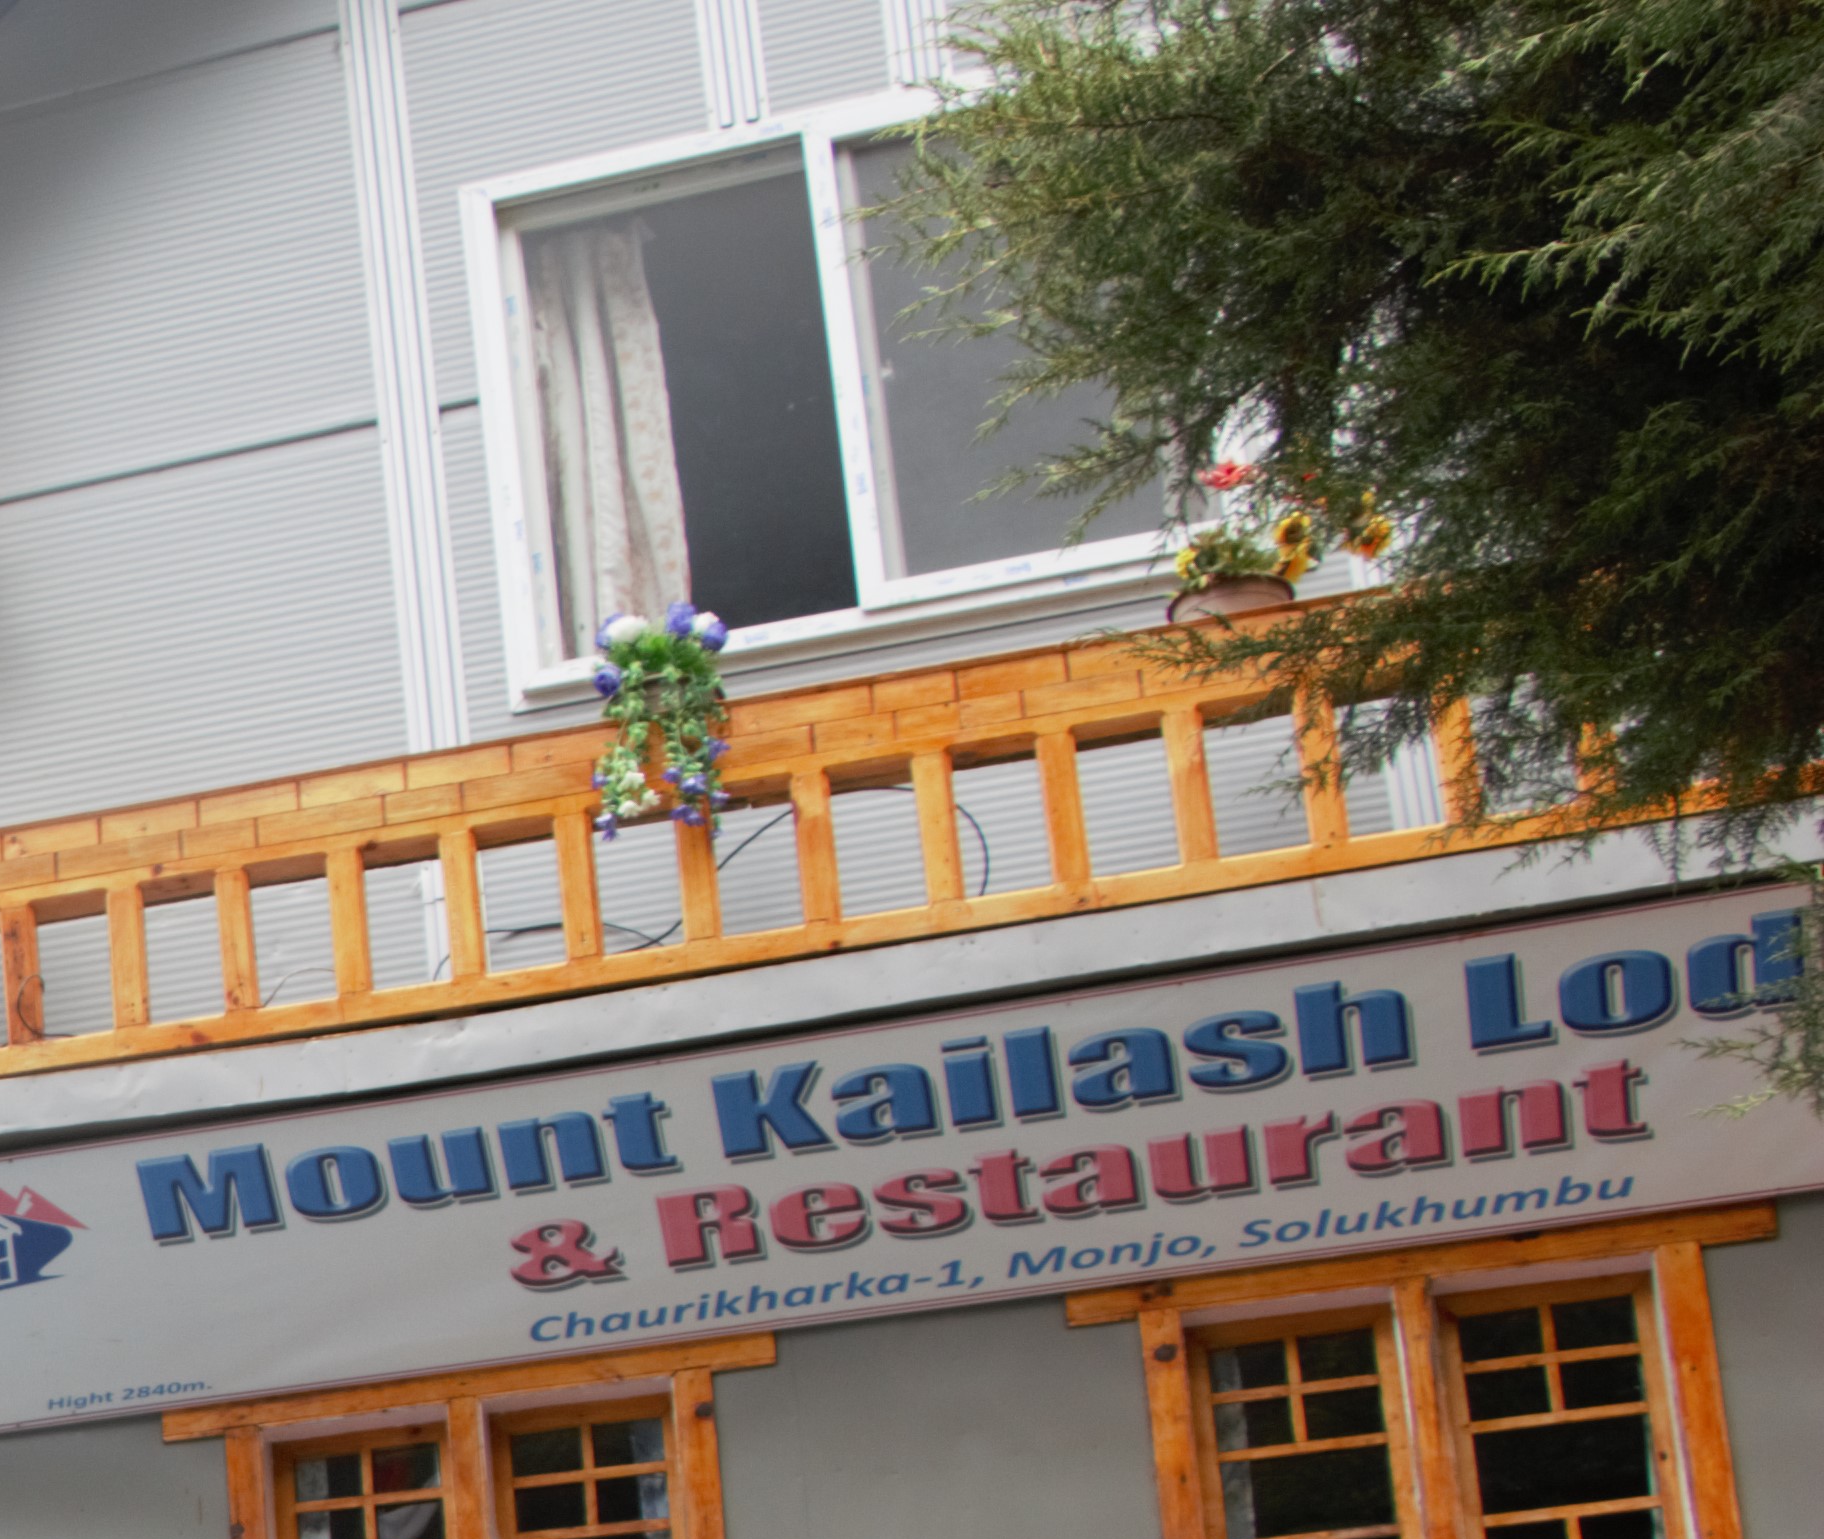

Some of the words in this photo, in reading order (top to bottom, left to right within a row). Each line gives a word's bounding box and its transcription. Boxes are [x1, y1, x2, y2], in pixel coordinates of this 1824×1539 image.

[135, 1091, 682, 1243] Mount
[710, 980, 1414, 1161] Kailash
[1464, 906, 1805, 1052] Lod
[509, 1218, 626, 1290] &
[655, 1057, 1654, 1269] Restaurant
[529, 1258, 985, 1344] Chaurikharka-1,
[1007, 1230, 1217, 1280] Monjo,
[1238, 1175, 1635, 1248] Solukhumbu
[48, 1391, 113, 1410] Hight
[122, 1381, 212, 1400] 2840m.
